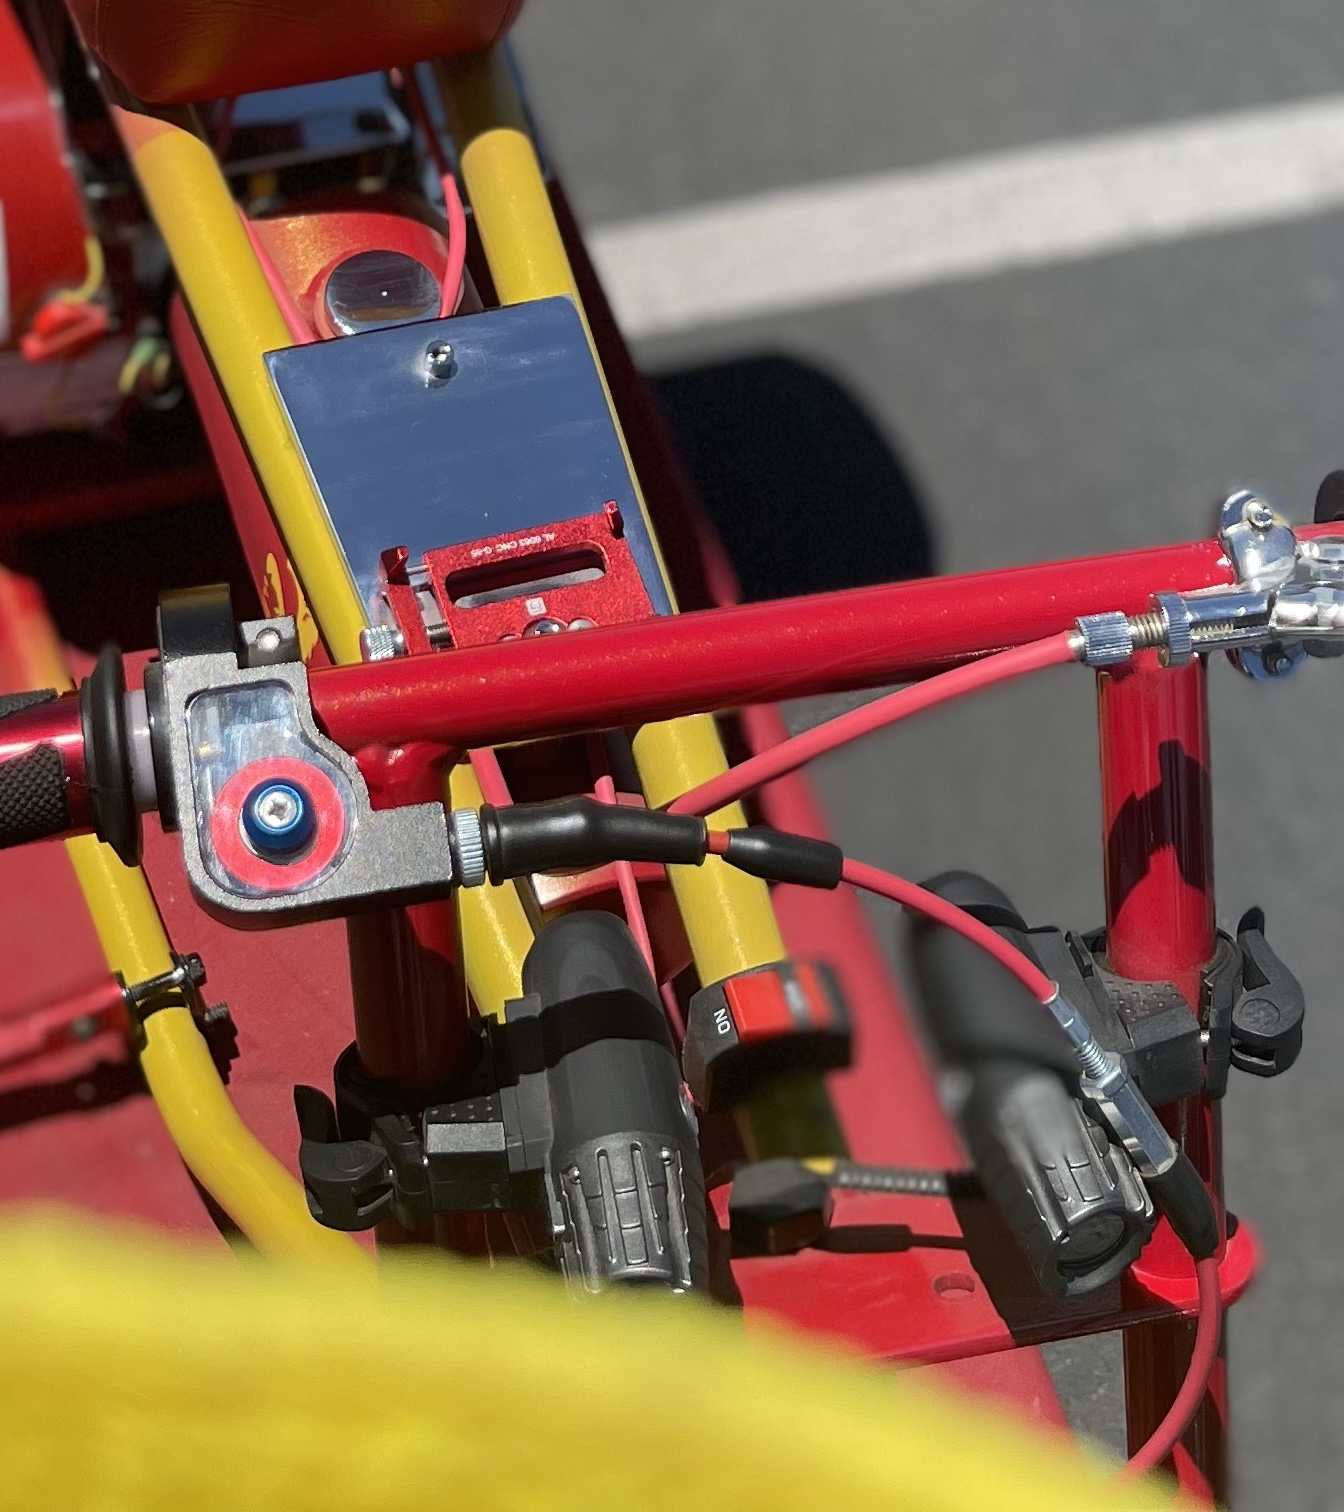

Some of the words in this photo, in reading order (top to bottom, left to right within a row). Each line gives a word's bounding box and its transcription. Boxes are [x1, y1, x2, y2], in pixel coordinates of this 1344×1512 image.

[542, 532, 555, 542] AL
[496, 540, 518, 551] CNC
[714, 1008, 731, 1034] ON
